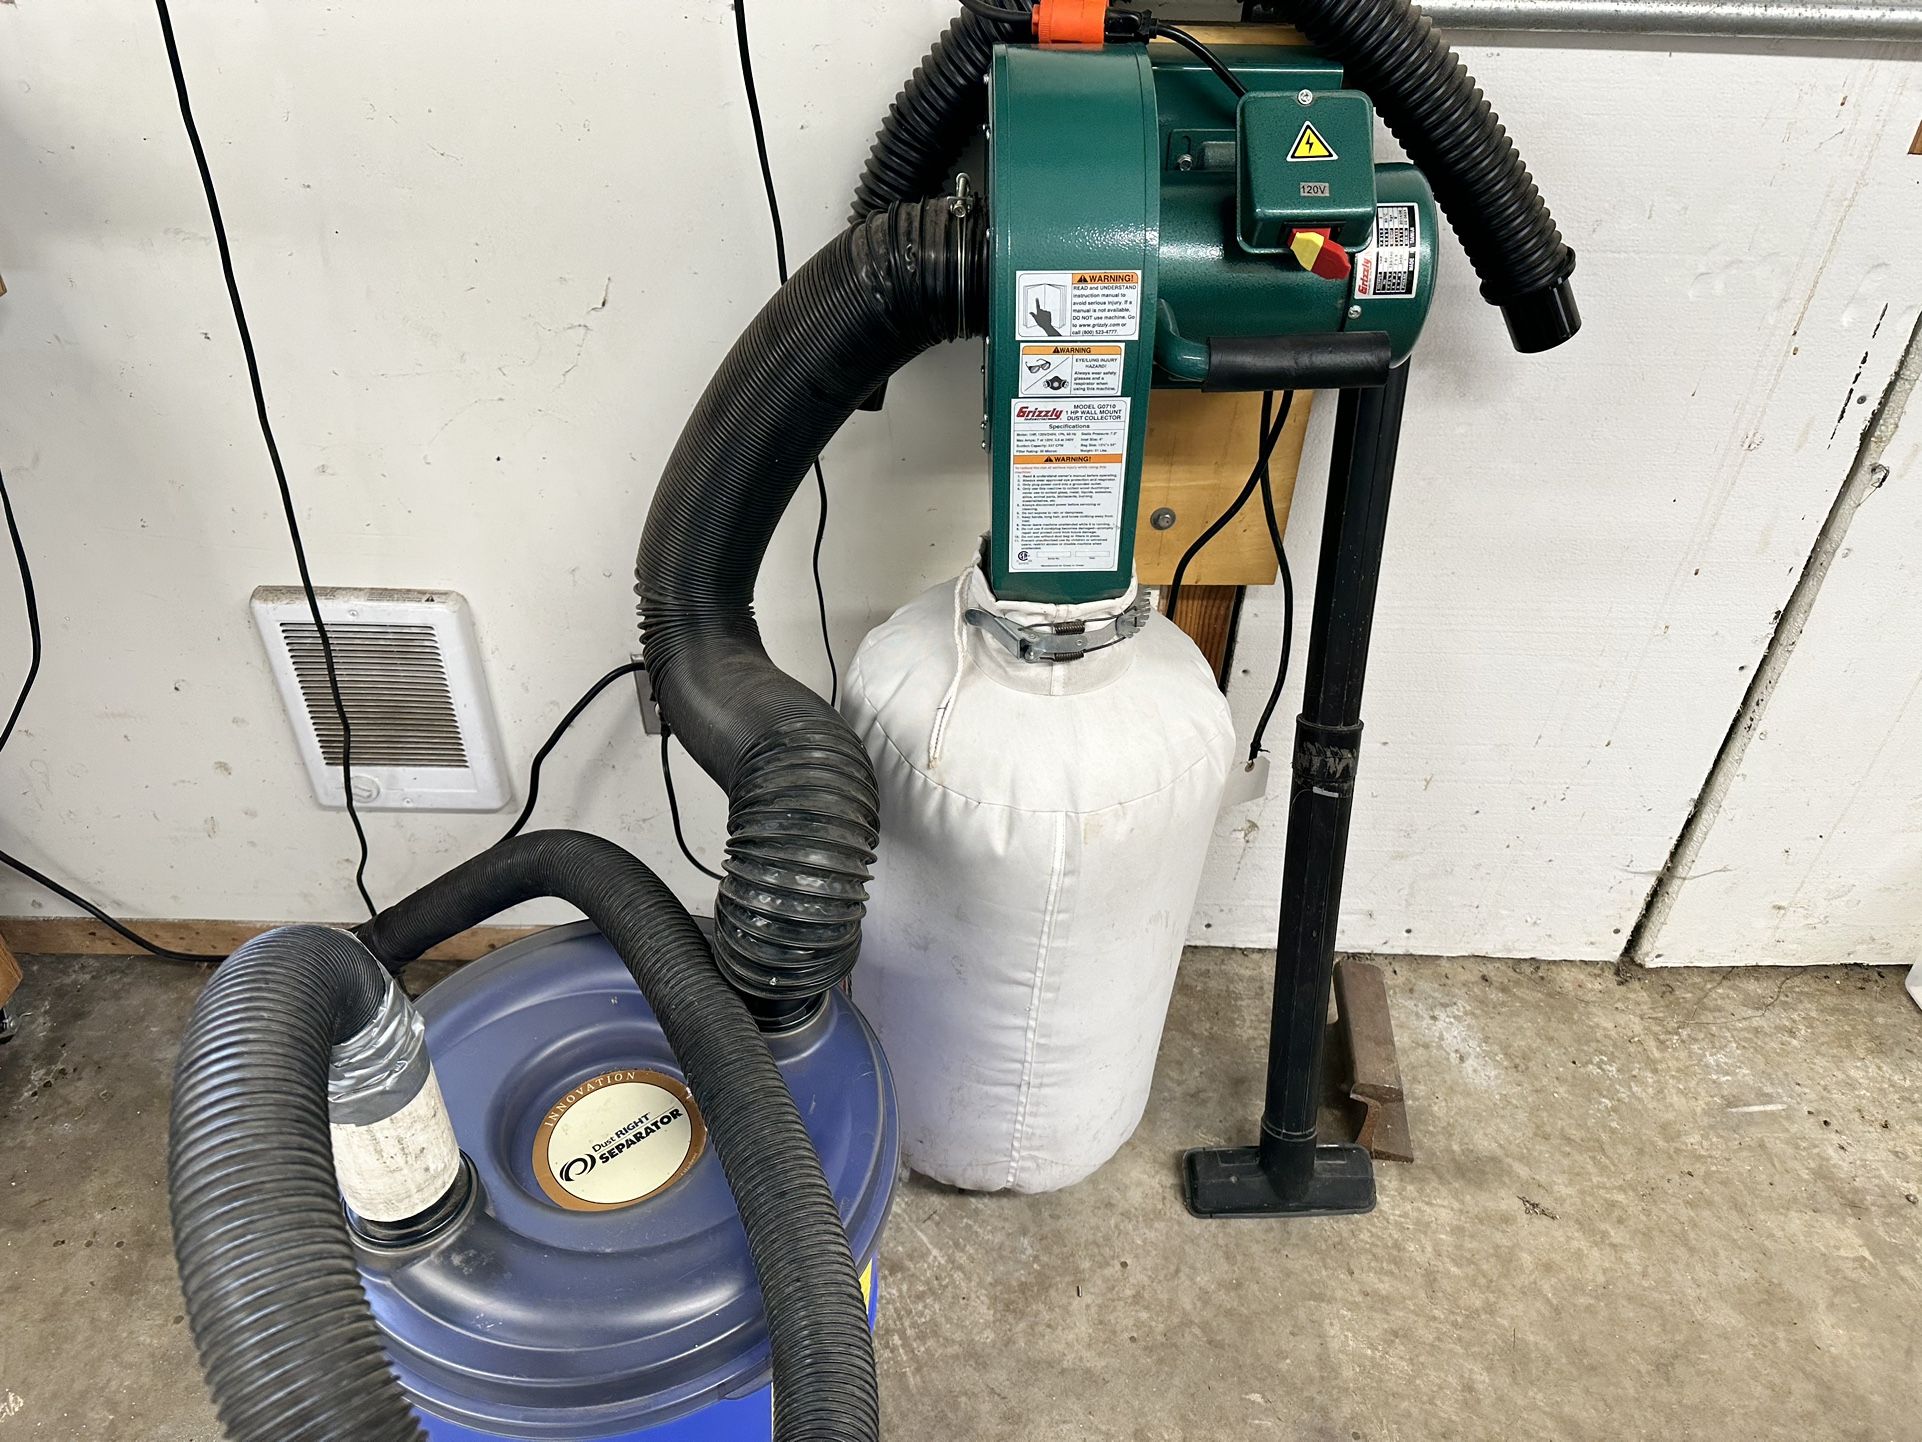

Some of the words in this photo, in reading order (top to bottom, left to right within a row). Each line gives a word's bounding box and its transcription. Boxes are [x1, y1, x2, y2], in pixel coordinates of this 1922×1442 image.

[1302, 186, 1325, 194] 120V
[1358, 259, 1372, 294] Grizzly
[1016, 406, 1063, 420] Grizzly
[544, 1072, 636, 1127] INNOVATION
[592, 1136, 616, 1153] Dust
[616, 1114, 650, 1138] RIGHT
[599, 1108, 683, 1164] SEPARATOR
